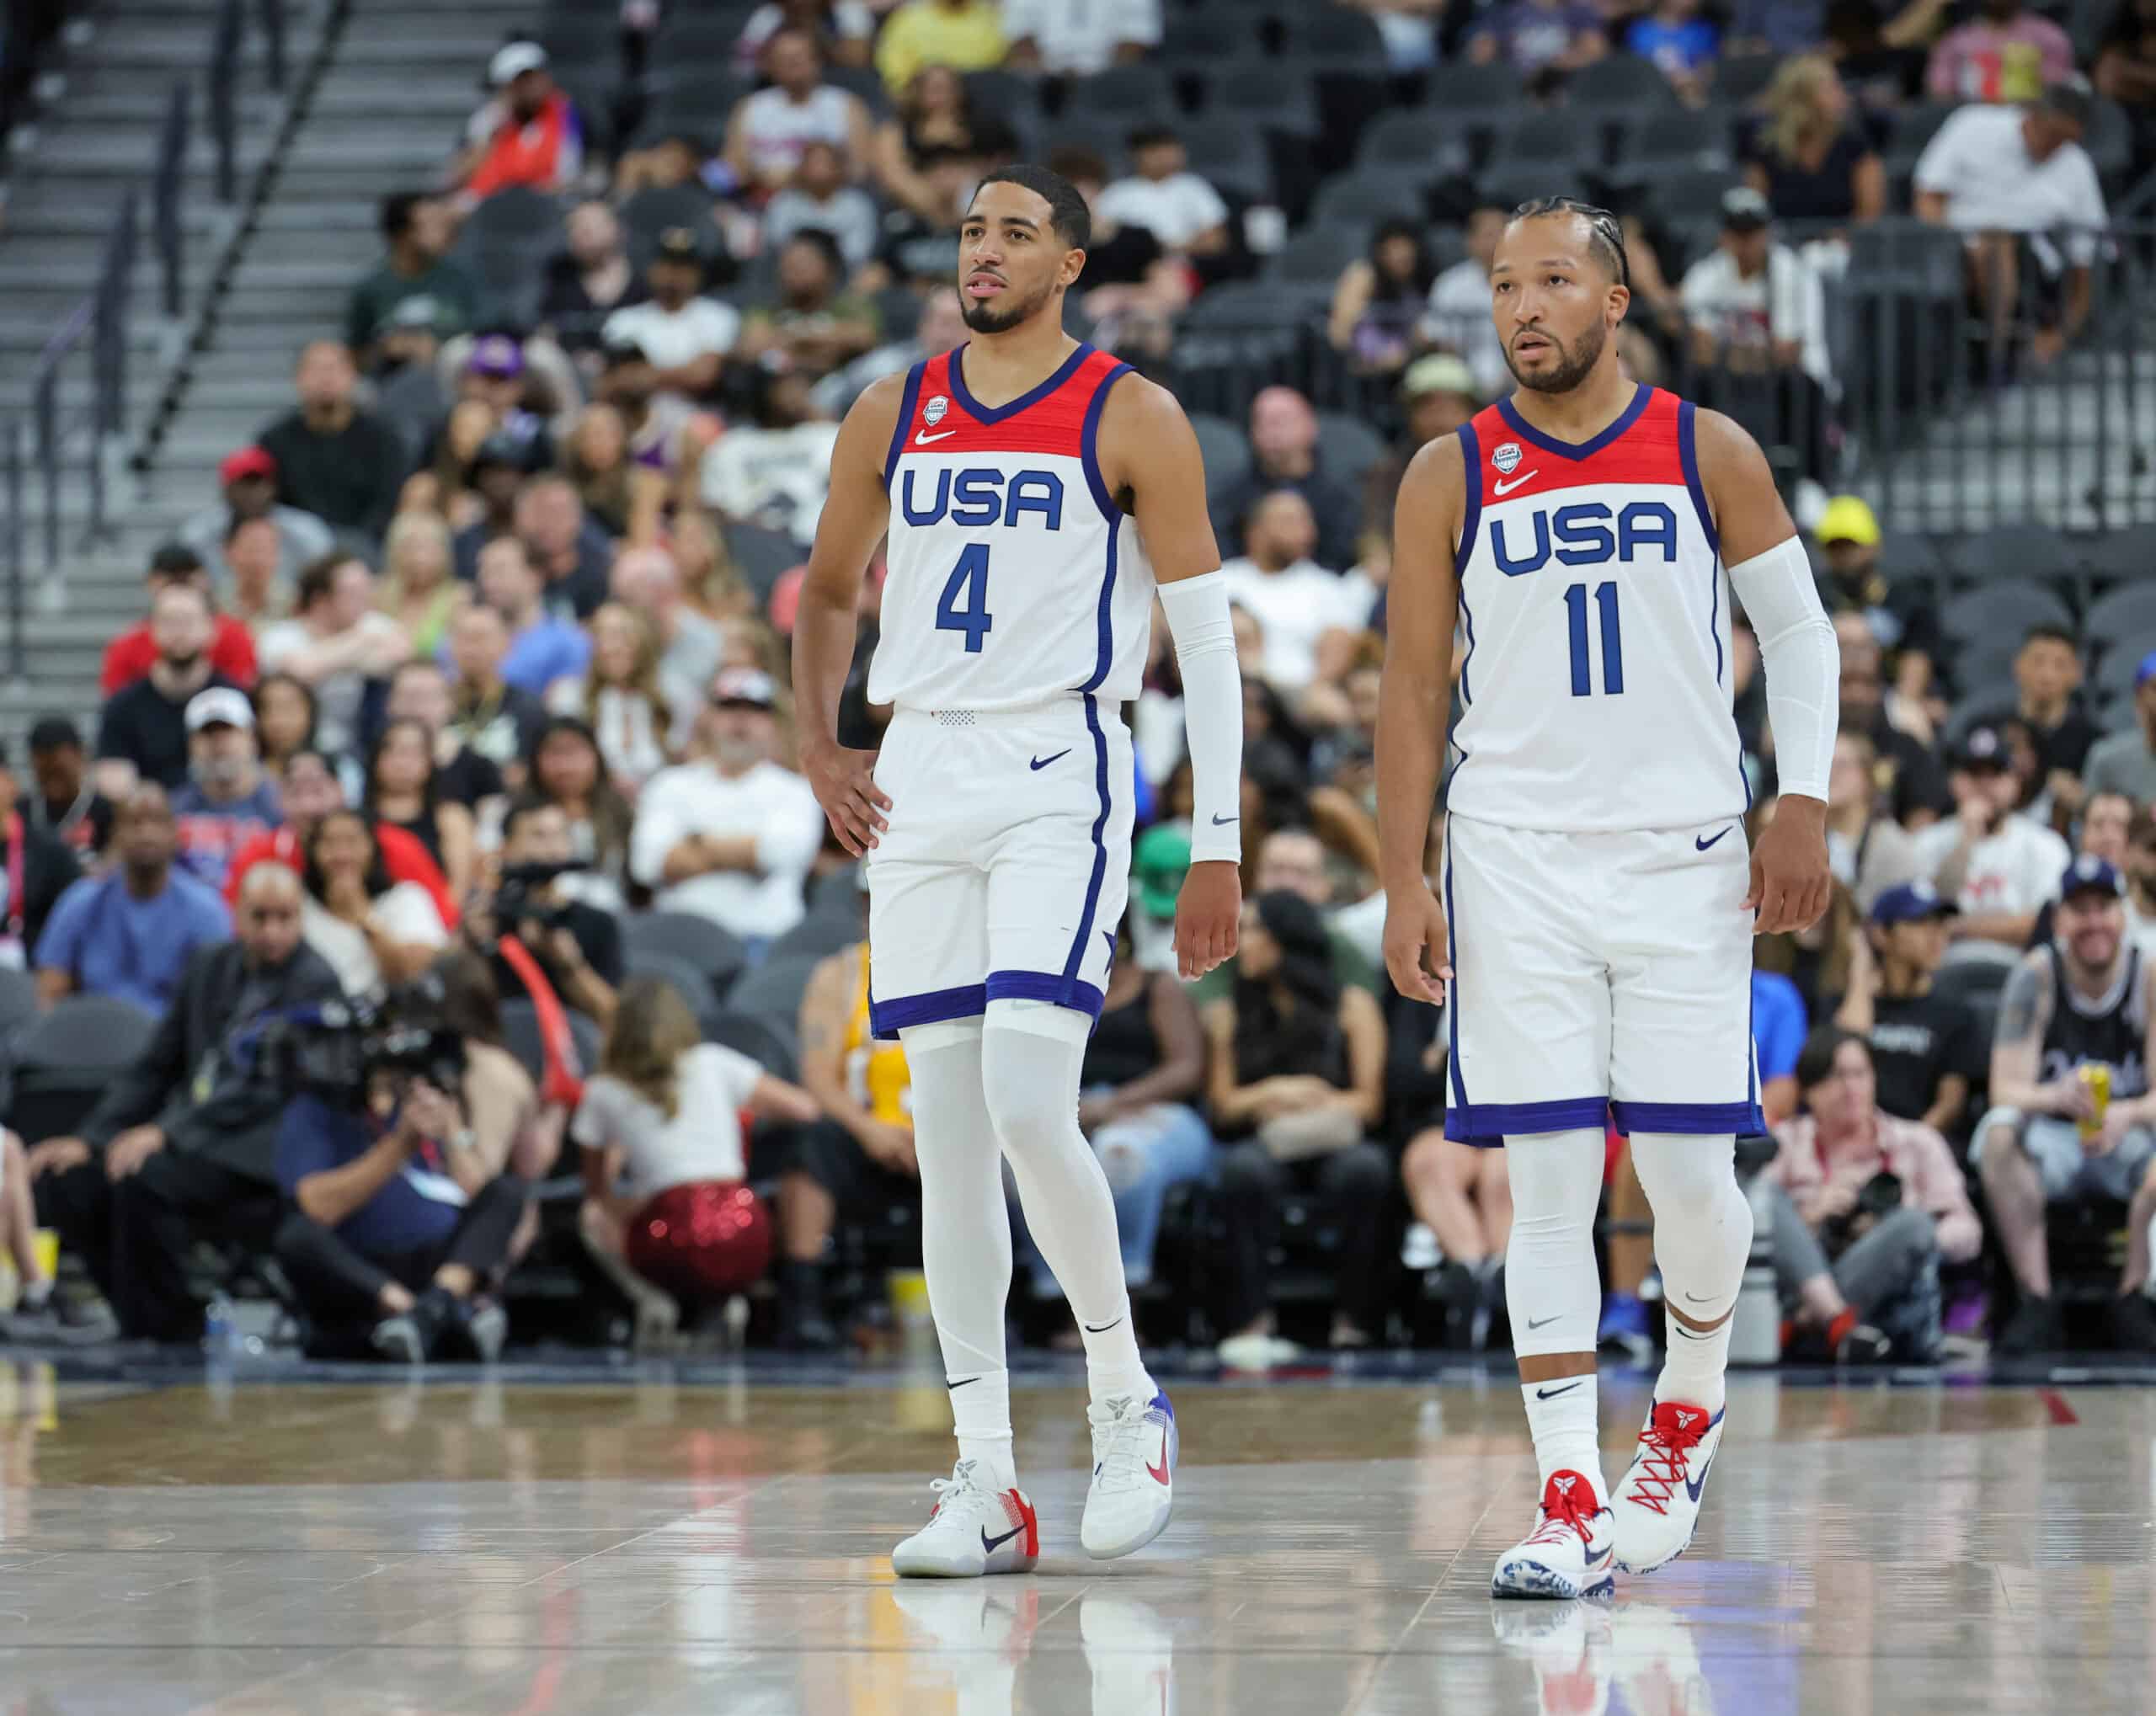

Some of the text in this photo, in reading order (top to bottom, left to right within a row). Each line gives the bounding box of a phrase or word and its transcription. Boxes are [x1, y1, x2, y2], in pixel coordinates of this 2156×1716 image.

[902, 468, 1064, 530] USA
[1490, 502, 1677, 577] USA
[935, 543, 992, 653] 4
[1563, 581, 1624, 696] 11
